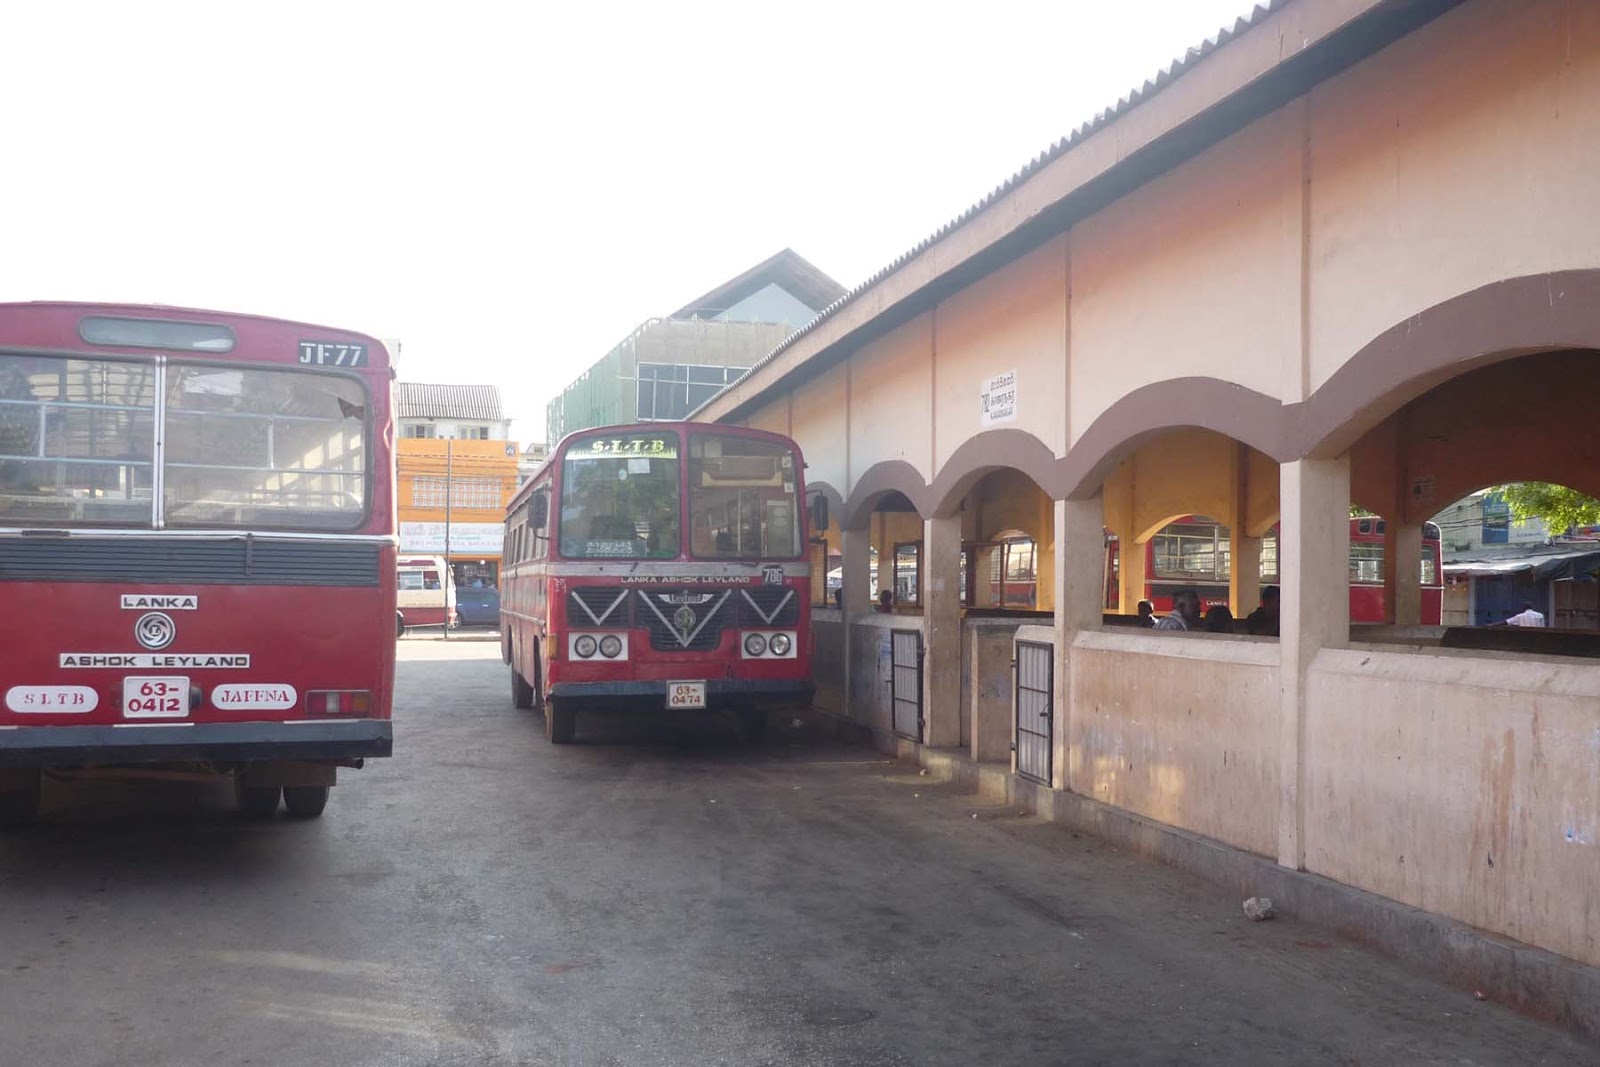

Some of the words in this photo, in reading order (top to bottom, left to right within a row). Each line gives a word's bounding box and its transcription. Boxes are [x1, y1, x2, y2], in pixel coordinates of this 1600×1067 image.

[300, 343, 362, 366] JF77
[620, 576, 657, 584] LANKA
[661, 576, 698, 584] ASHOK
[702, 576, 751, 584] LEYLAND
[123, 597, 195, 608] LANKA
[63, 655, 137, 667] ASHOK
[152, 655, 249, 667] LEYLAND
[221, 688, 289, 704] JAFFNA
[672, 695, 701, 704] 0474
[128, 697, 181, 712] 0412
